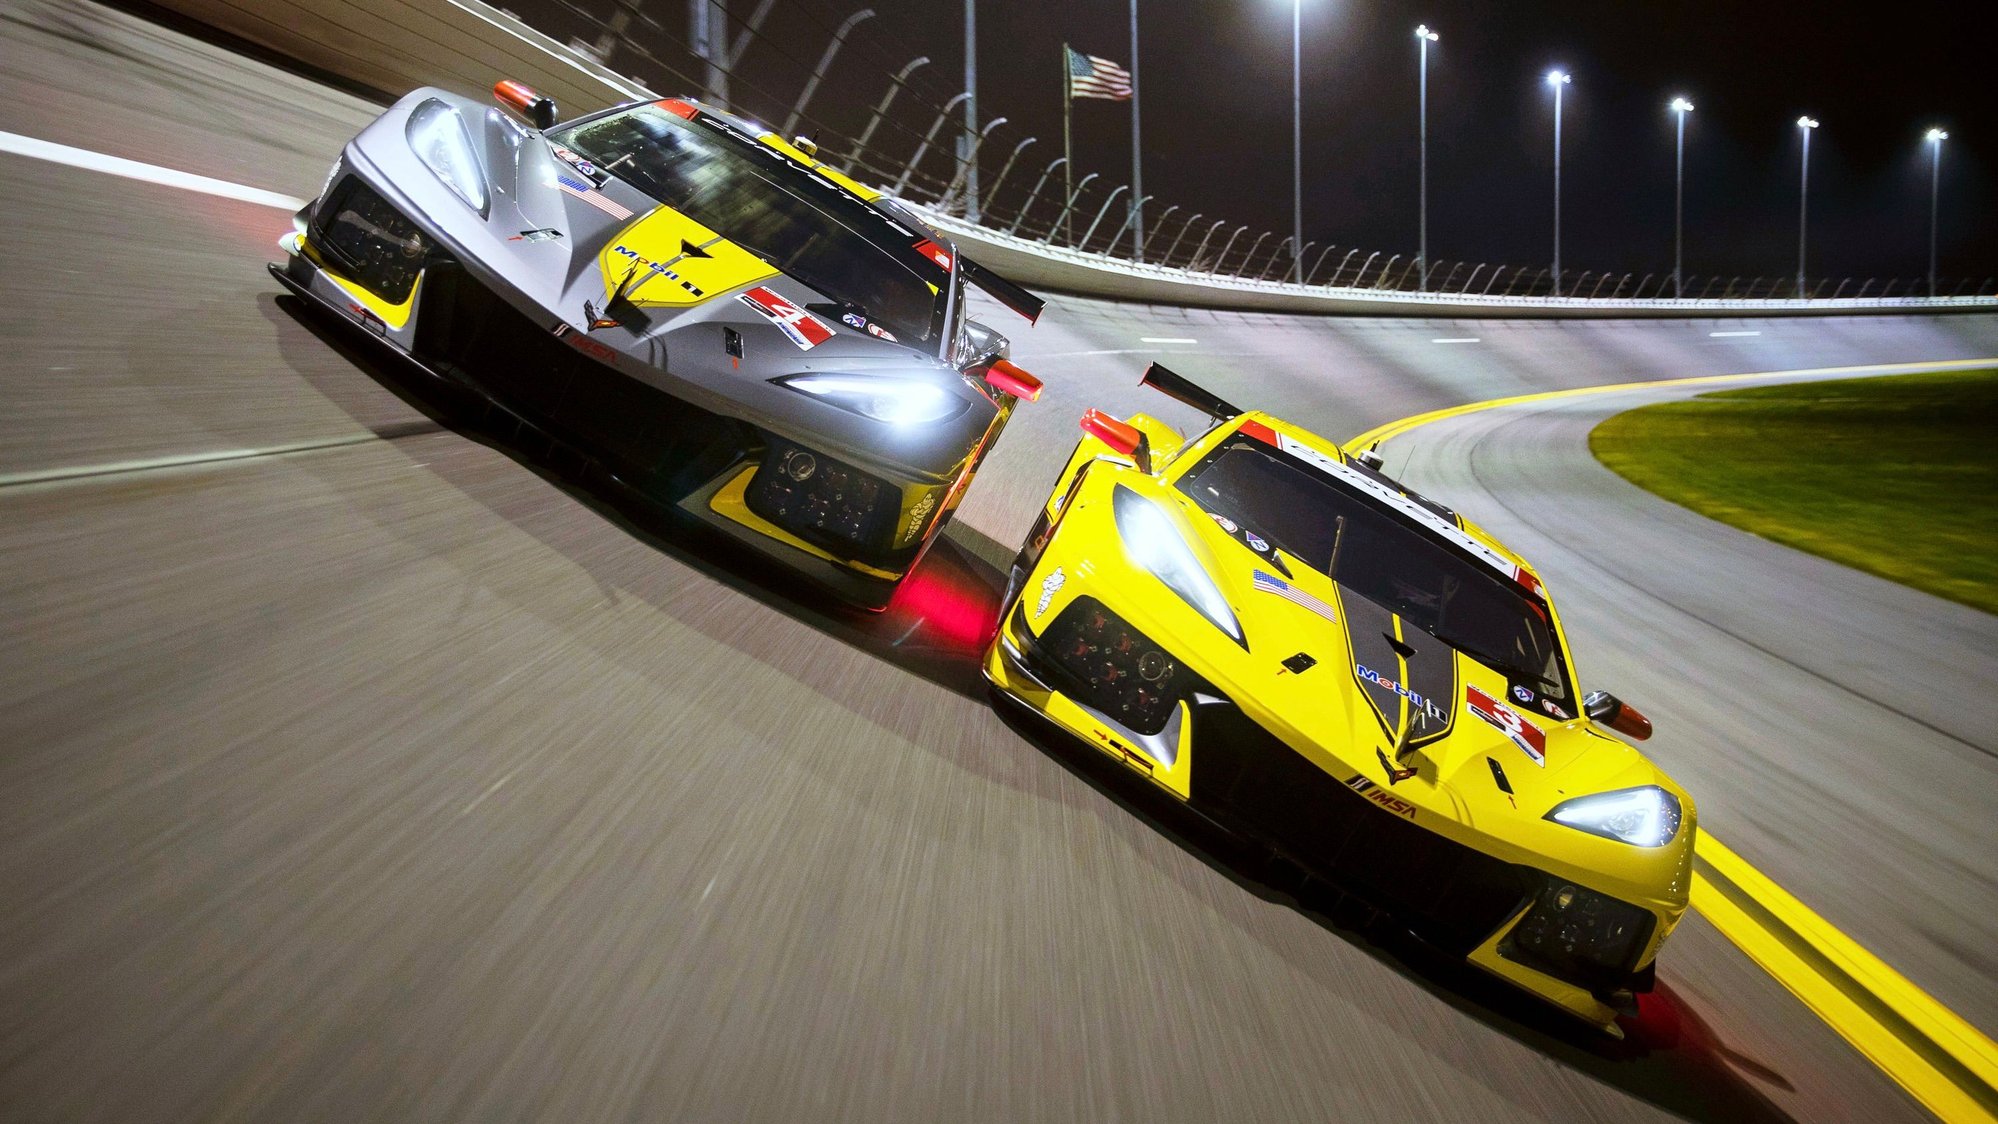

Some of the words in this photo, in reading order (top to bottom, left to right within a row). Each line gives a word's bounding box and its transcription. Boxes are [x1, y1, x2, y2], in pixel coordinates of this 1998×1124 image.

[701, 118, 914, 237] CORVETTE
[614, 245, 679, 281] Mobil
[771, 303, 807, 325] 4
[1291, 445, 1507, 565] CORVETTE
[1356, 664, 1423, 707] Mobil
[1493, 704, 1523, 732] 3
[1367, 789, 1417, 819] IMSA
